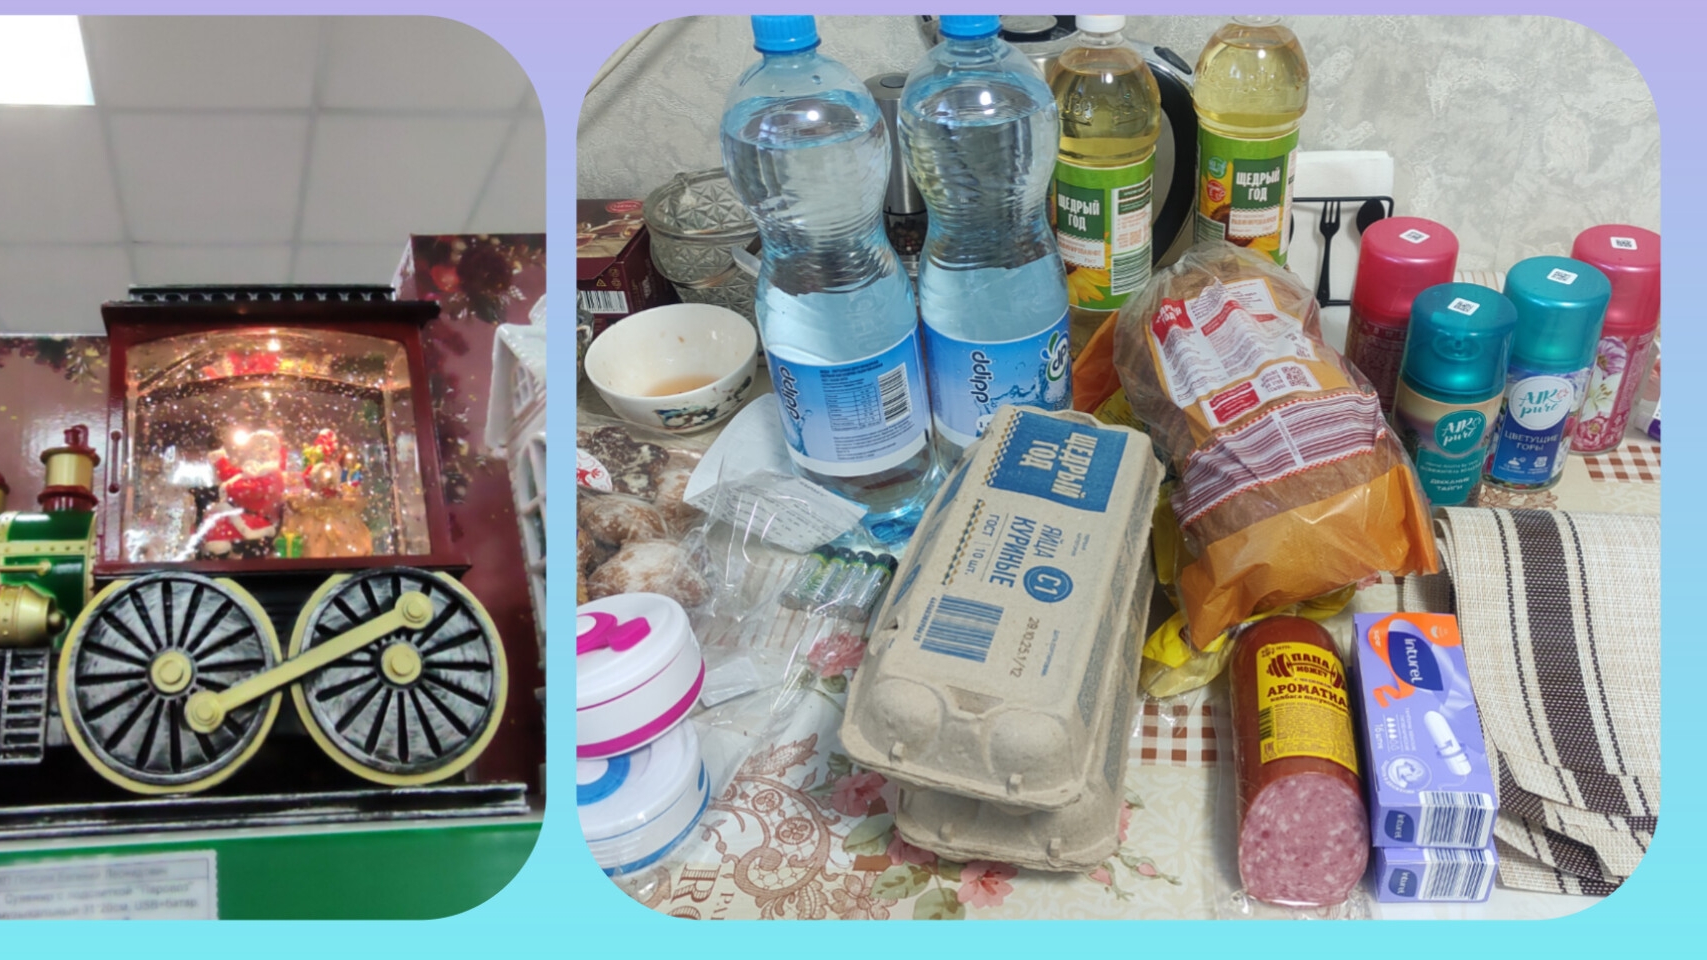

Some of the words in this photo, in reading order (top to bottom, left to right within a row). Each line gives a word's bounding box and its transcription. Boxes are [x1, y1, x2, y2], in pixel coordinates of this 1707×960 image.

[1236, 166, 1281, 188] ЩЕДРЫЙ
[1057, 193, 1100, 216] ЩЕДРЫЙ
[1248, 187, 1268, 202] ГОД
[1068, 213, 1087, 232] ГОД
[1504, 430, 1559, 445] ЦВЕТУЩИЕ
[1516, 442, 1545, 451] ГОРЫ
[1018, 440, 1060, 471] ГОД
[1051, 431, 1098, 500] ЩЕДРЫЙ
[982, 514, 1000, 537] ГОСТ
[989, 516, 1037, 589] КУРИНЫЕ
[1033, 524, 1063, 559] ЯЙЦА
[972, 547, 986, 560] 10
[1291, 653, 1330, 670] ПАПА
[1296, 665, 1329, 679] МОЖЕТ
[1404, 638, 1424, 684] inturel
